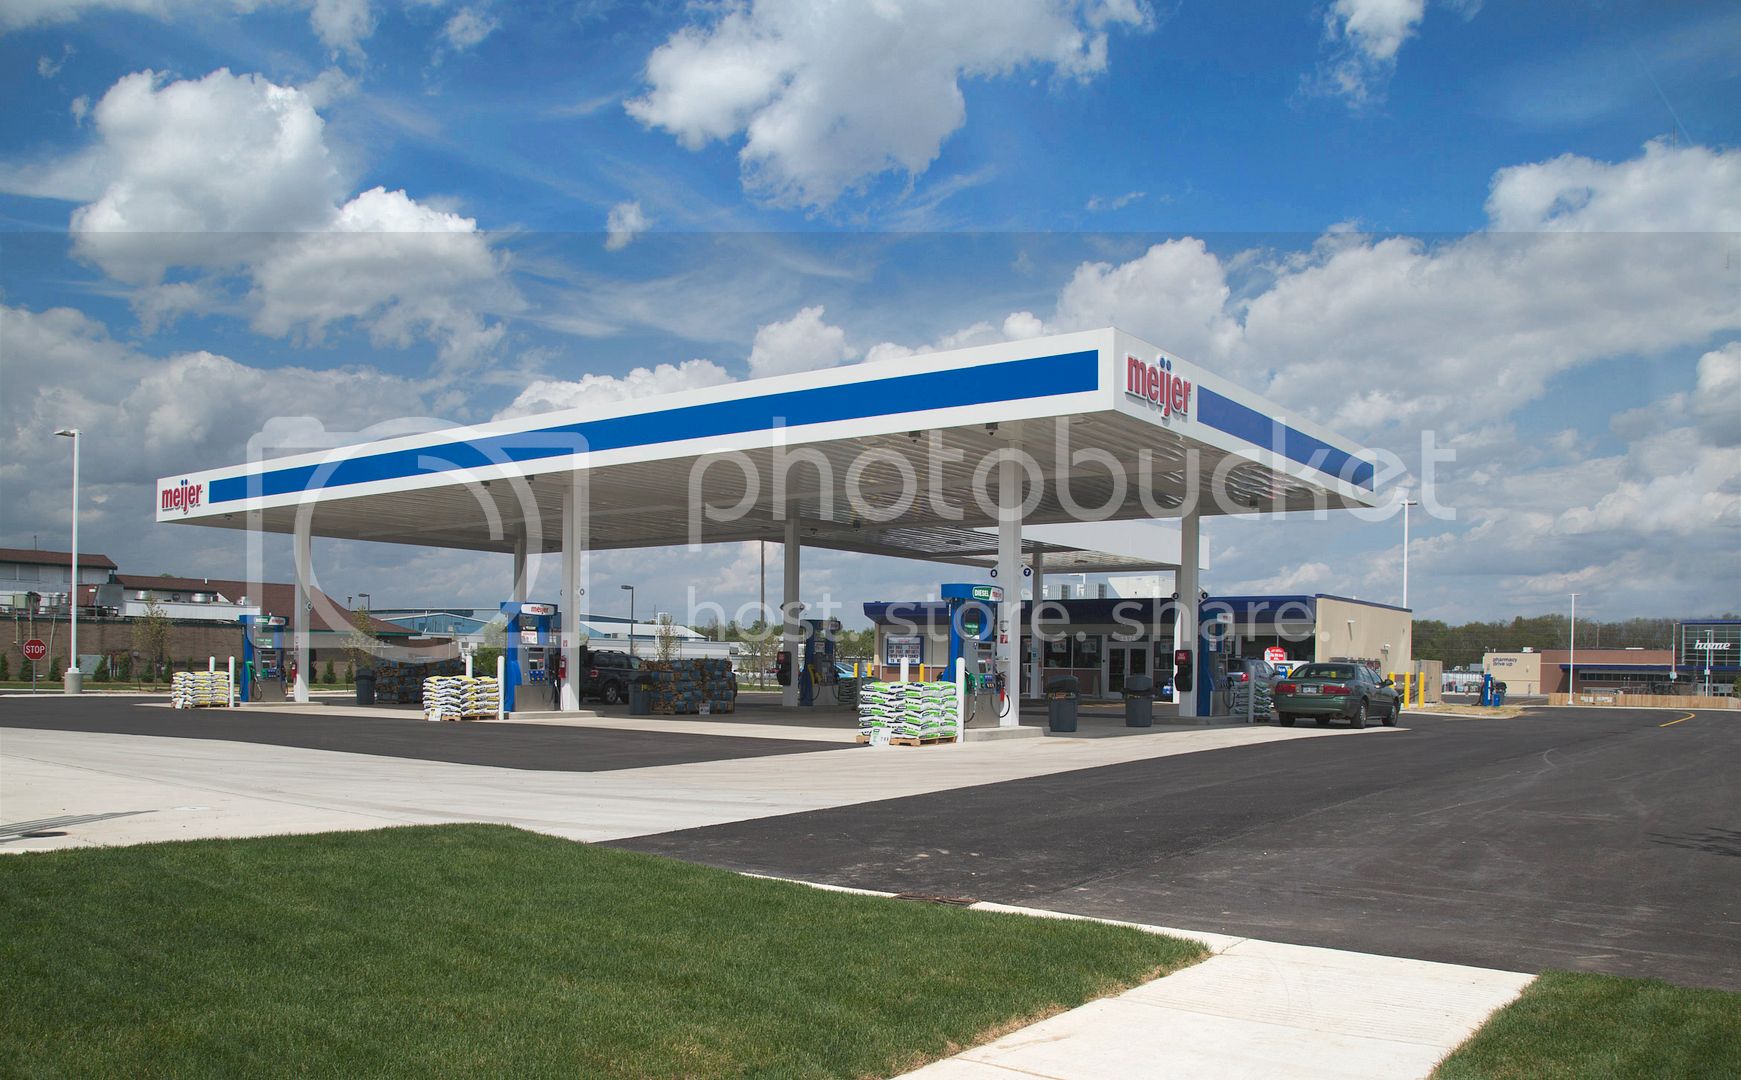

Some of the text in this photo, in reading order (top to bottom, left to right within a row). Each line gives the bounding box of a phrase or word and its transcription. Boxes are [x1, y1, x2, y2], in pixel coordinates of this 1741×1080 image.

[1126, 355, 1191, 417] meijer
[161, 478, 202, 512] meijer
[974, 589, 990, 597] DIESEL
[25, 645, 45, 654] STOP
[1695, 639, 1731, 650] home
